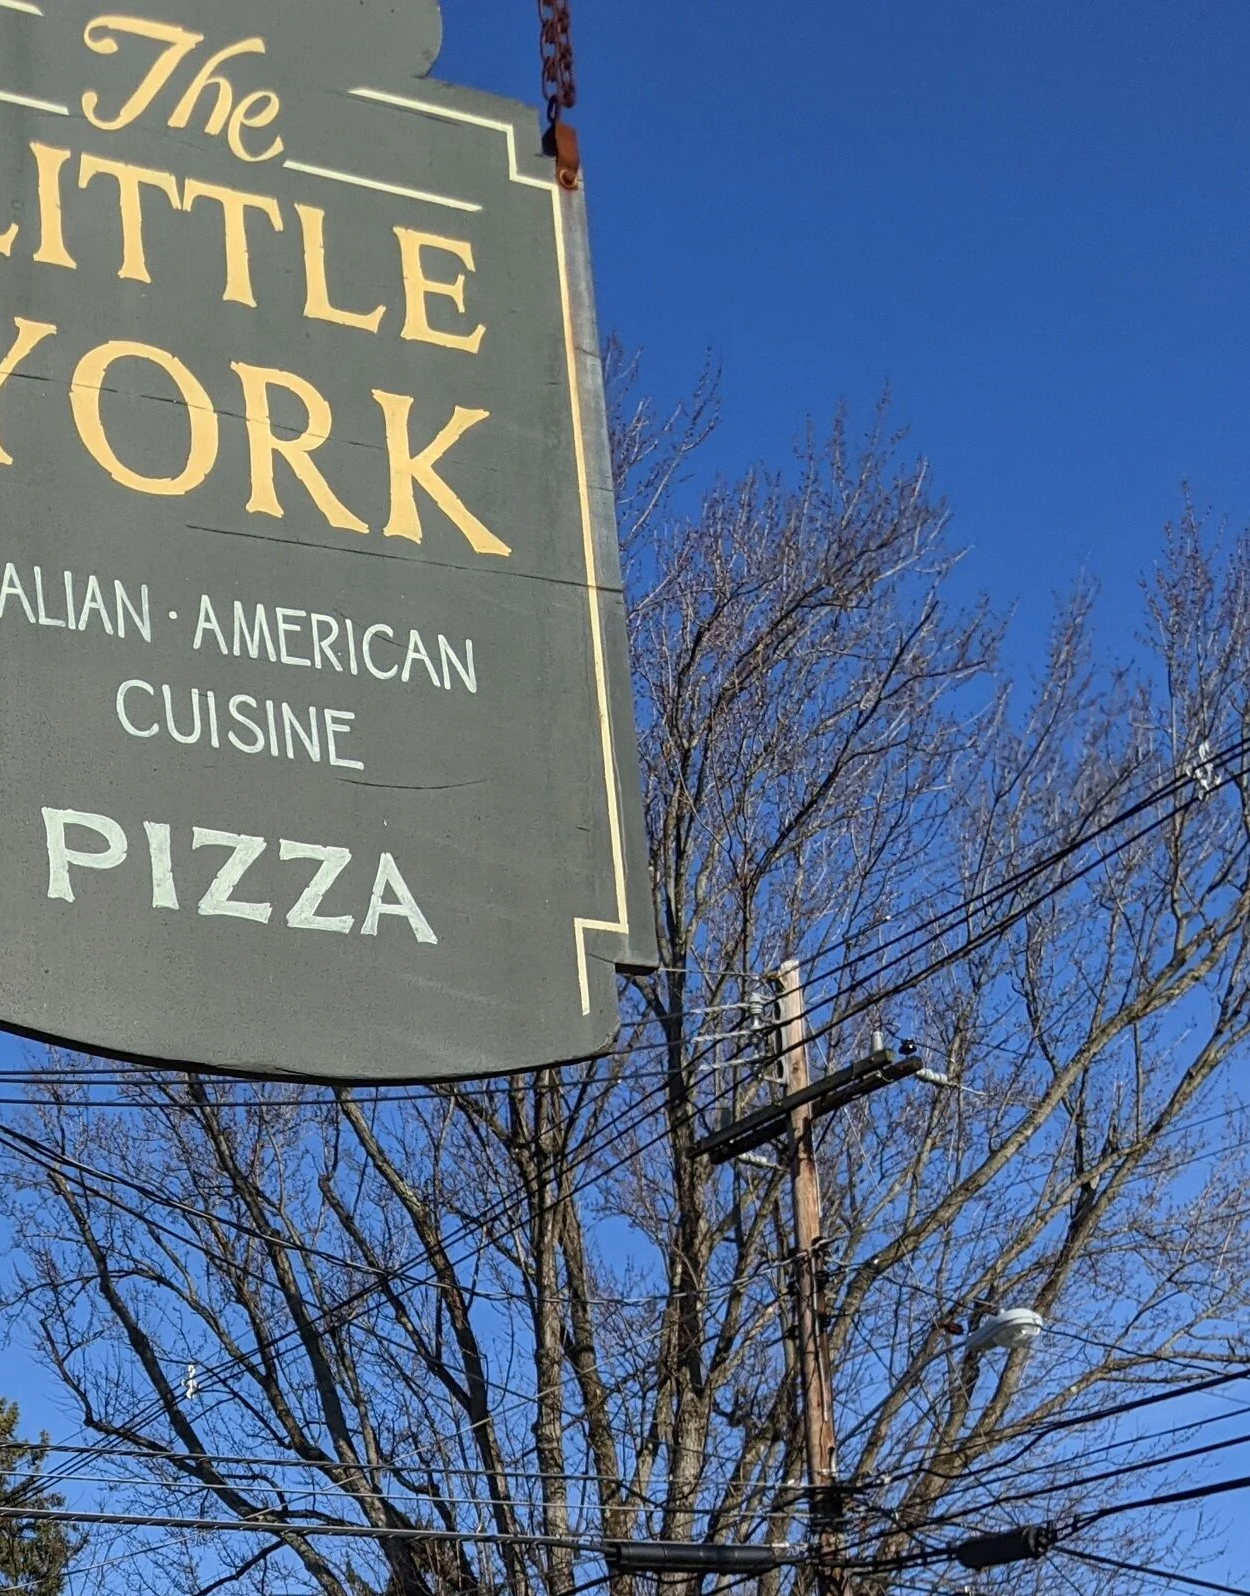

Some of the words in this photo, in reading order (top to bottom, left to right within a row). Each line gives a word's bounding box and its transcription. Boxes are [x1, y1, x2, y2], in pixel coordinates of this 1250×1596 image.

[81, 14, 286, 162] The
[192, 594, 477, 694] AMERICAN
[116, 679, 365, 771] CUISINE
[40, 806, 439, 945] PIZZA
